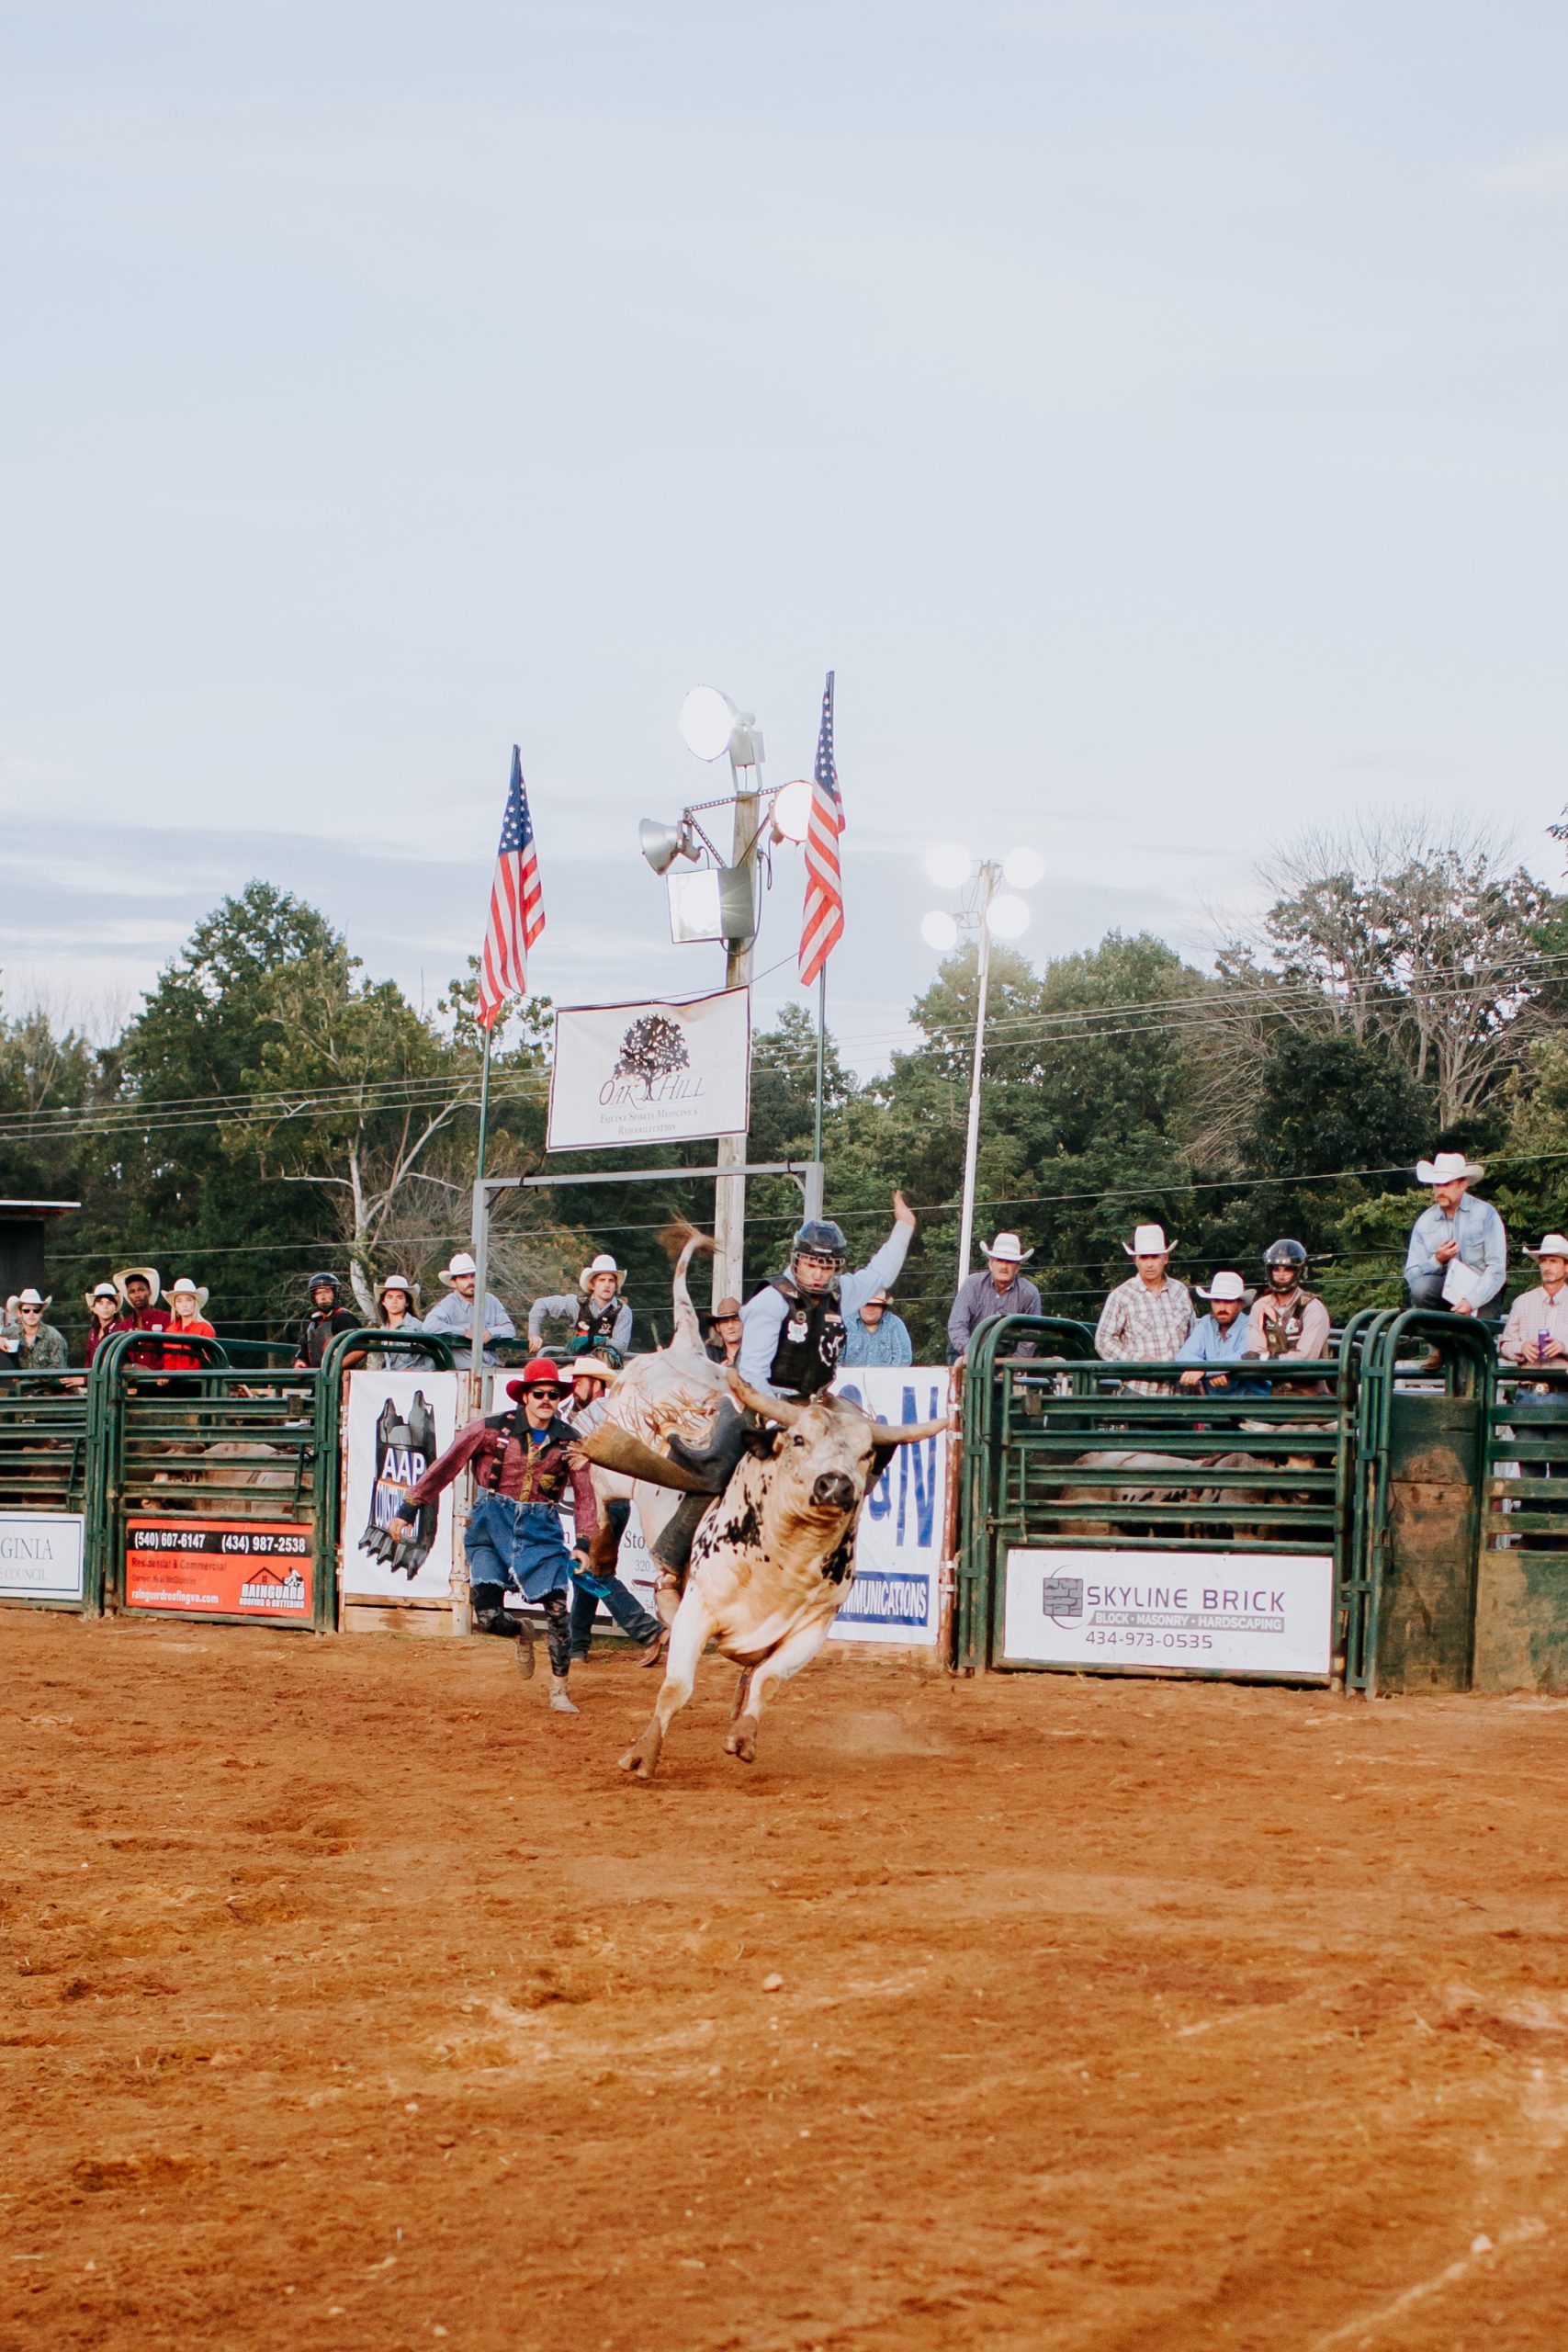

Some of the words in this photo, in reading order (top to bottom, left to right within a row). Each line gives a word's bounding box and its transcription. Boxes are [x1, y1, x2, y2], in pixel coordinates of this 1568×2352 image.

[599, 1080, 643, 1110] OAK
[657, 1074, 705, 1101] HILL
[382, 1447, 426, 1487] AAP
[0, 1537, 53, 1560] GINIA
[134, 1532, 159, 1550] (540)
[161, 1532, 206, 1549] 607-6147
[221, 1534, 249, 1554] (434)
[253, 1535, 306, 1554] 987-2538
[180, 1559, 227, 1571] Commercial
[242, 1583, 305, 1600] RAINGUARD
[838, 1579, 927, 1618] MMUNICATIONS
[1087, 1586, 1188, 1609] SKYLINE
[1202, 1589, 1285, 1611] BRICK
[1095, 1611, 1129, 1624] BLOCK
[1136, 1613, 1190, 1627] MASONRY
[1198, 1616, 1282, 1631] HARDSCAPING
[1086, 1631, 1213, 1649] 434-973-0535
